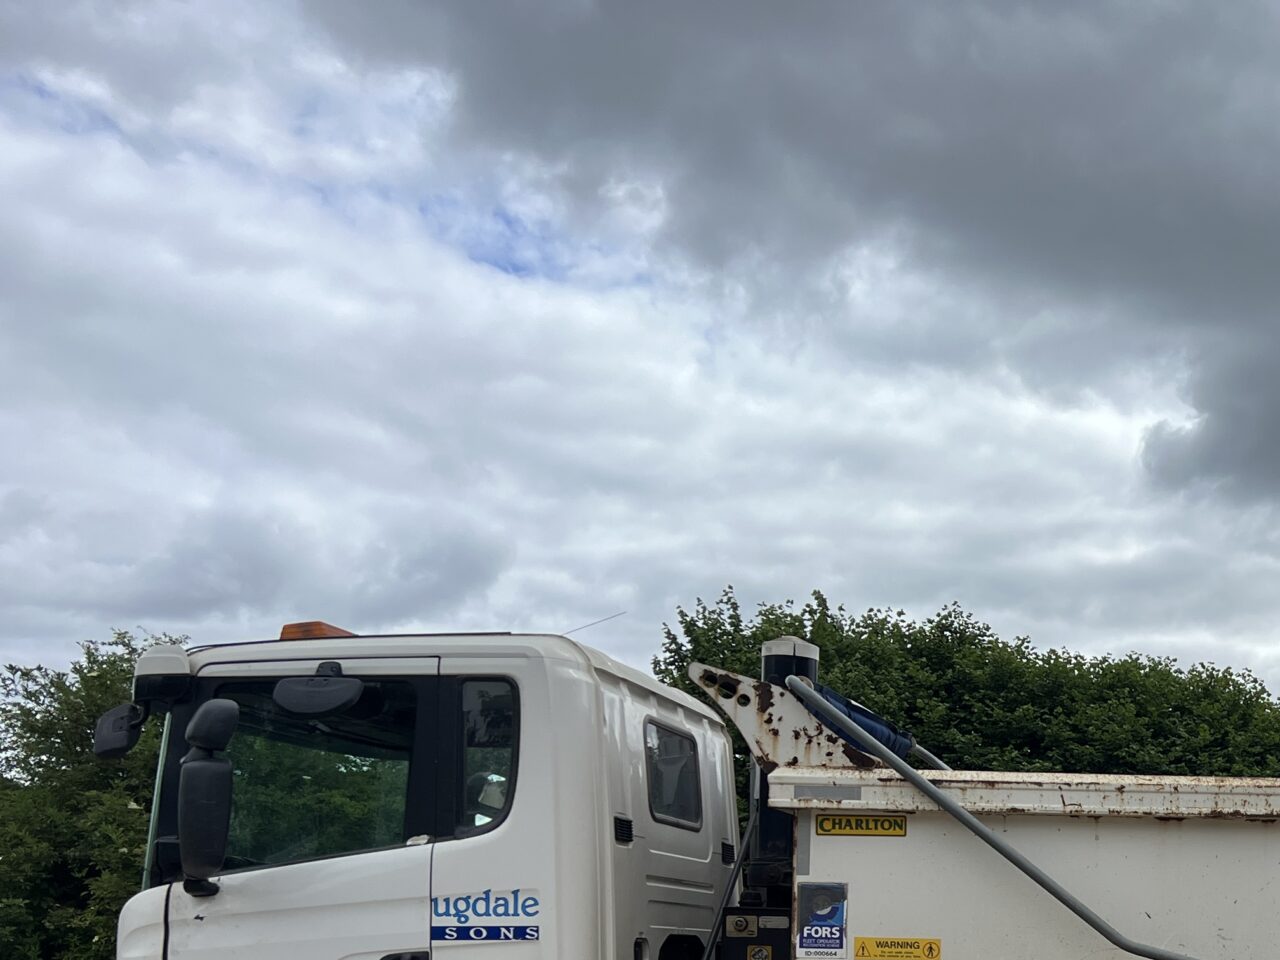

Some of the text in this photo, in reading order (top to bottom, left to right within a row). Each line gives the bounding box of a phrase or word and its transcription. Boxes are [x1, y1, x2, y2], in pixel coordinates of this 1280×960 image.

[818, 817, 904, 833] CHARLTON
[431, 888, 540, 925] ugdale
[444, 927, 538, 940] SONS
[803, 926, 840, 938] FORS
[875, 940, 920, 950] WARNING
